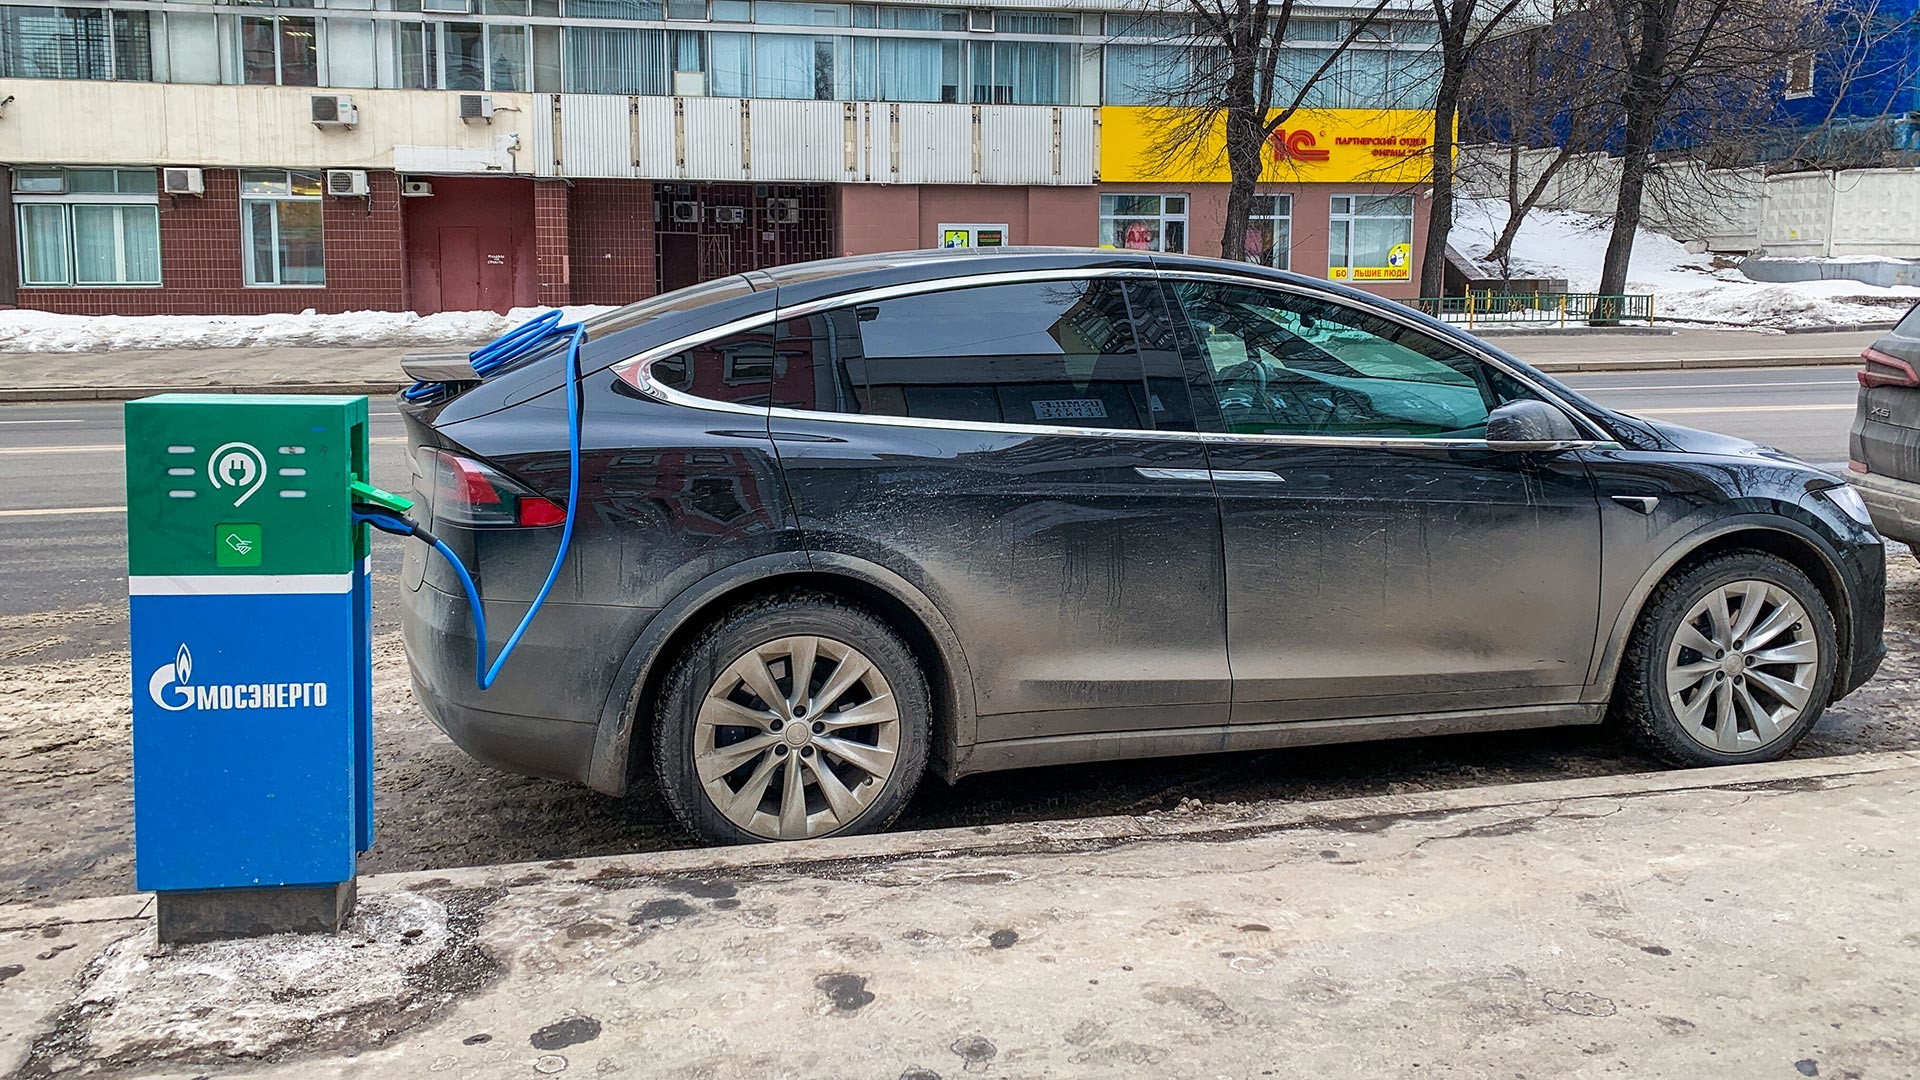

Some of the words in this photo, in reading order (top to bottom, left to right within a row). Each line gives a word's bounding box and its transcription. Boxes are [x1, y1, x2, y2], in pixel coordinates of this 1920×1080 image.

[1335, 136, 1397, 146] ПАРТНЕРСКИЙ
[1399, 137, 1427, 147] ОТДЕЛ
[1371, 148, 1406, 157] ФИРМЫ
[1384, 269, 1408, 278] ЛЮДИ
[1871, 405, 1891, 418] X5
[197, 682, 328, 711] МОСЭНЕРГО
